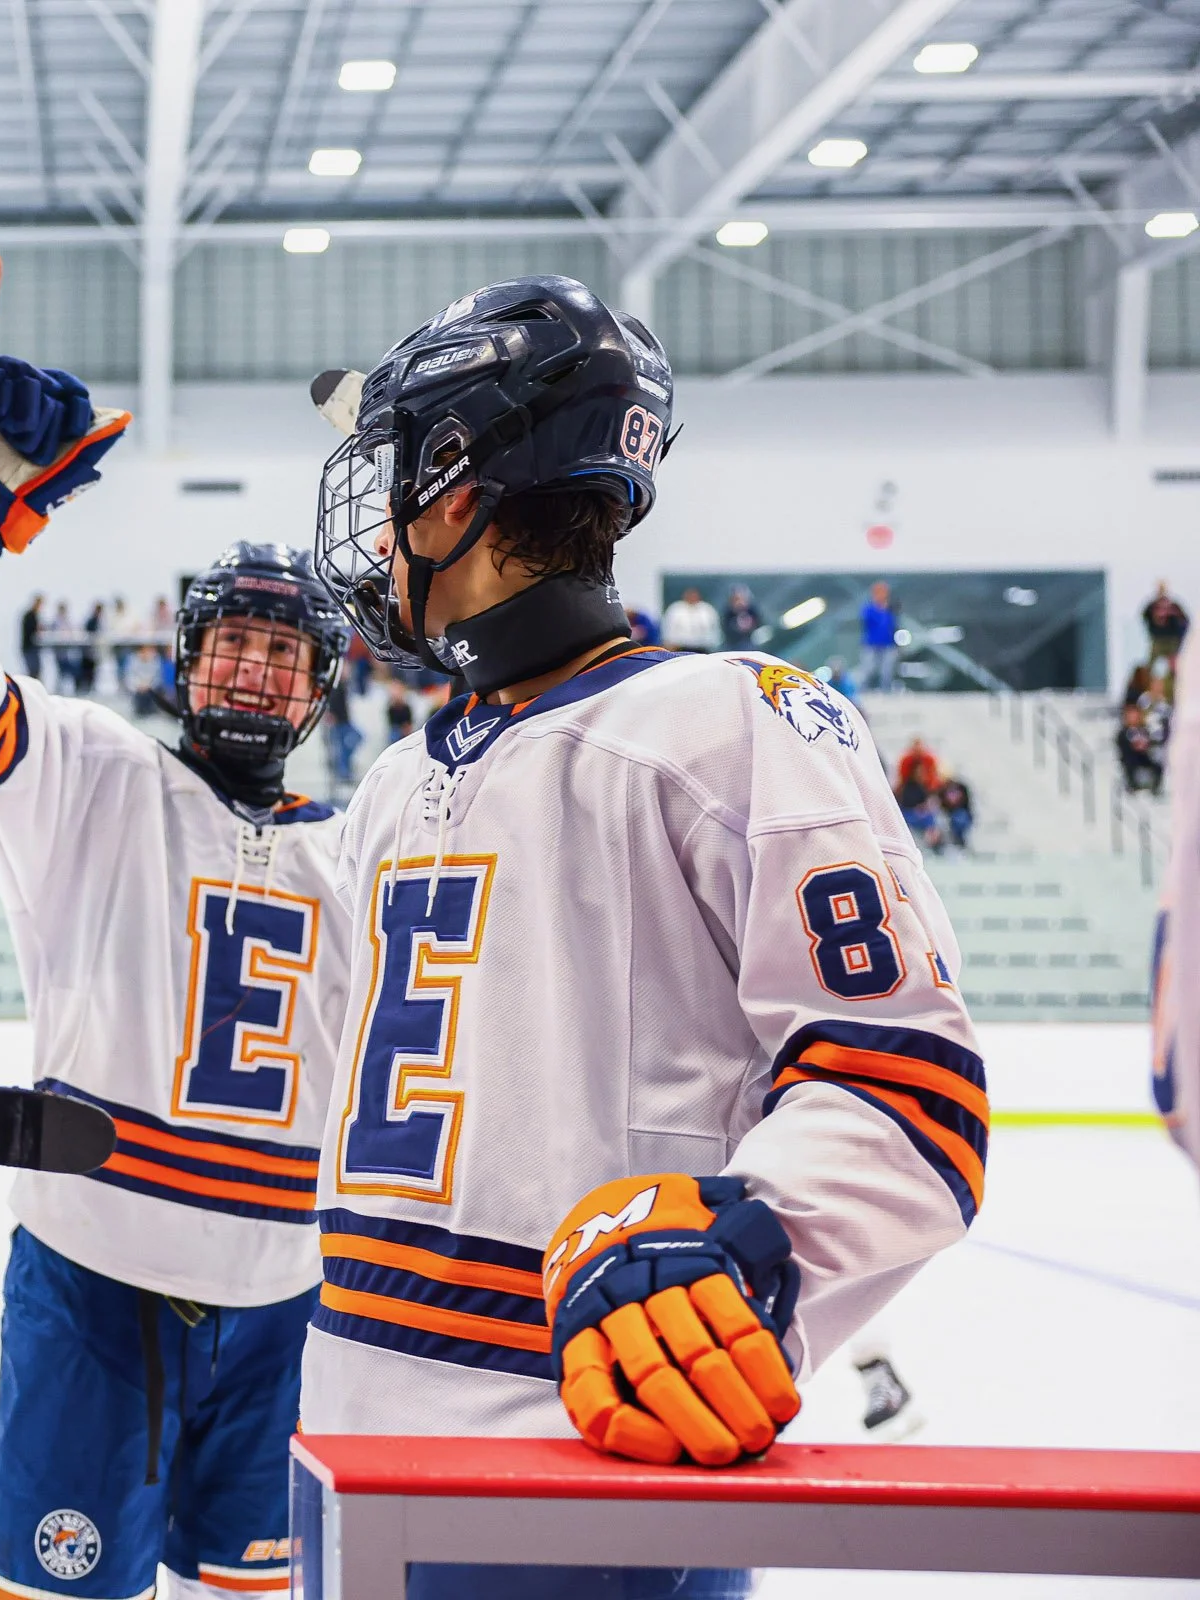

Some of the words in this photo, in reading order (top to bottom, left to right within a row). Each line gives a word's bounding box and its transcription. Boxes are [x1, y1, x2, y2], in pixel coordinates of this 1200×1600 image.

[415, 345, 486, 373] BAUER
[417, 455, 471, 507] BAUER
[620, 404, 663, 471] 87
[795, 860, 956, 1001] 8
[170, 876, 320, 1129] E
[336, 853, 497, 1205] E
